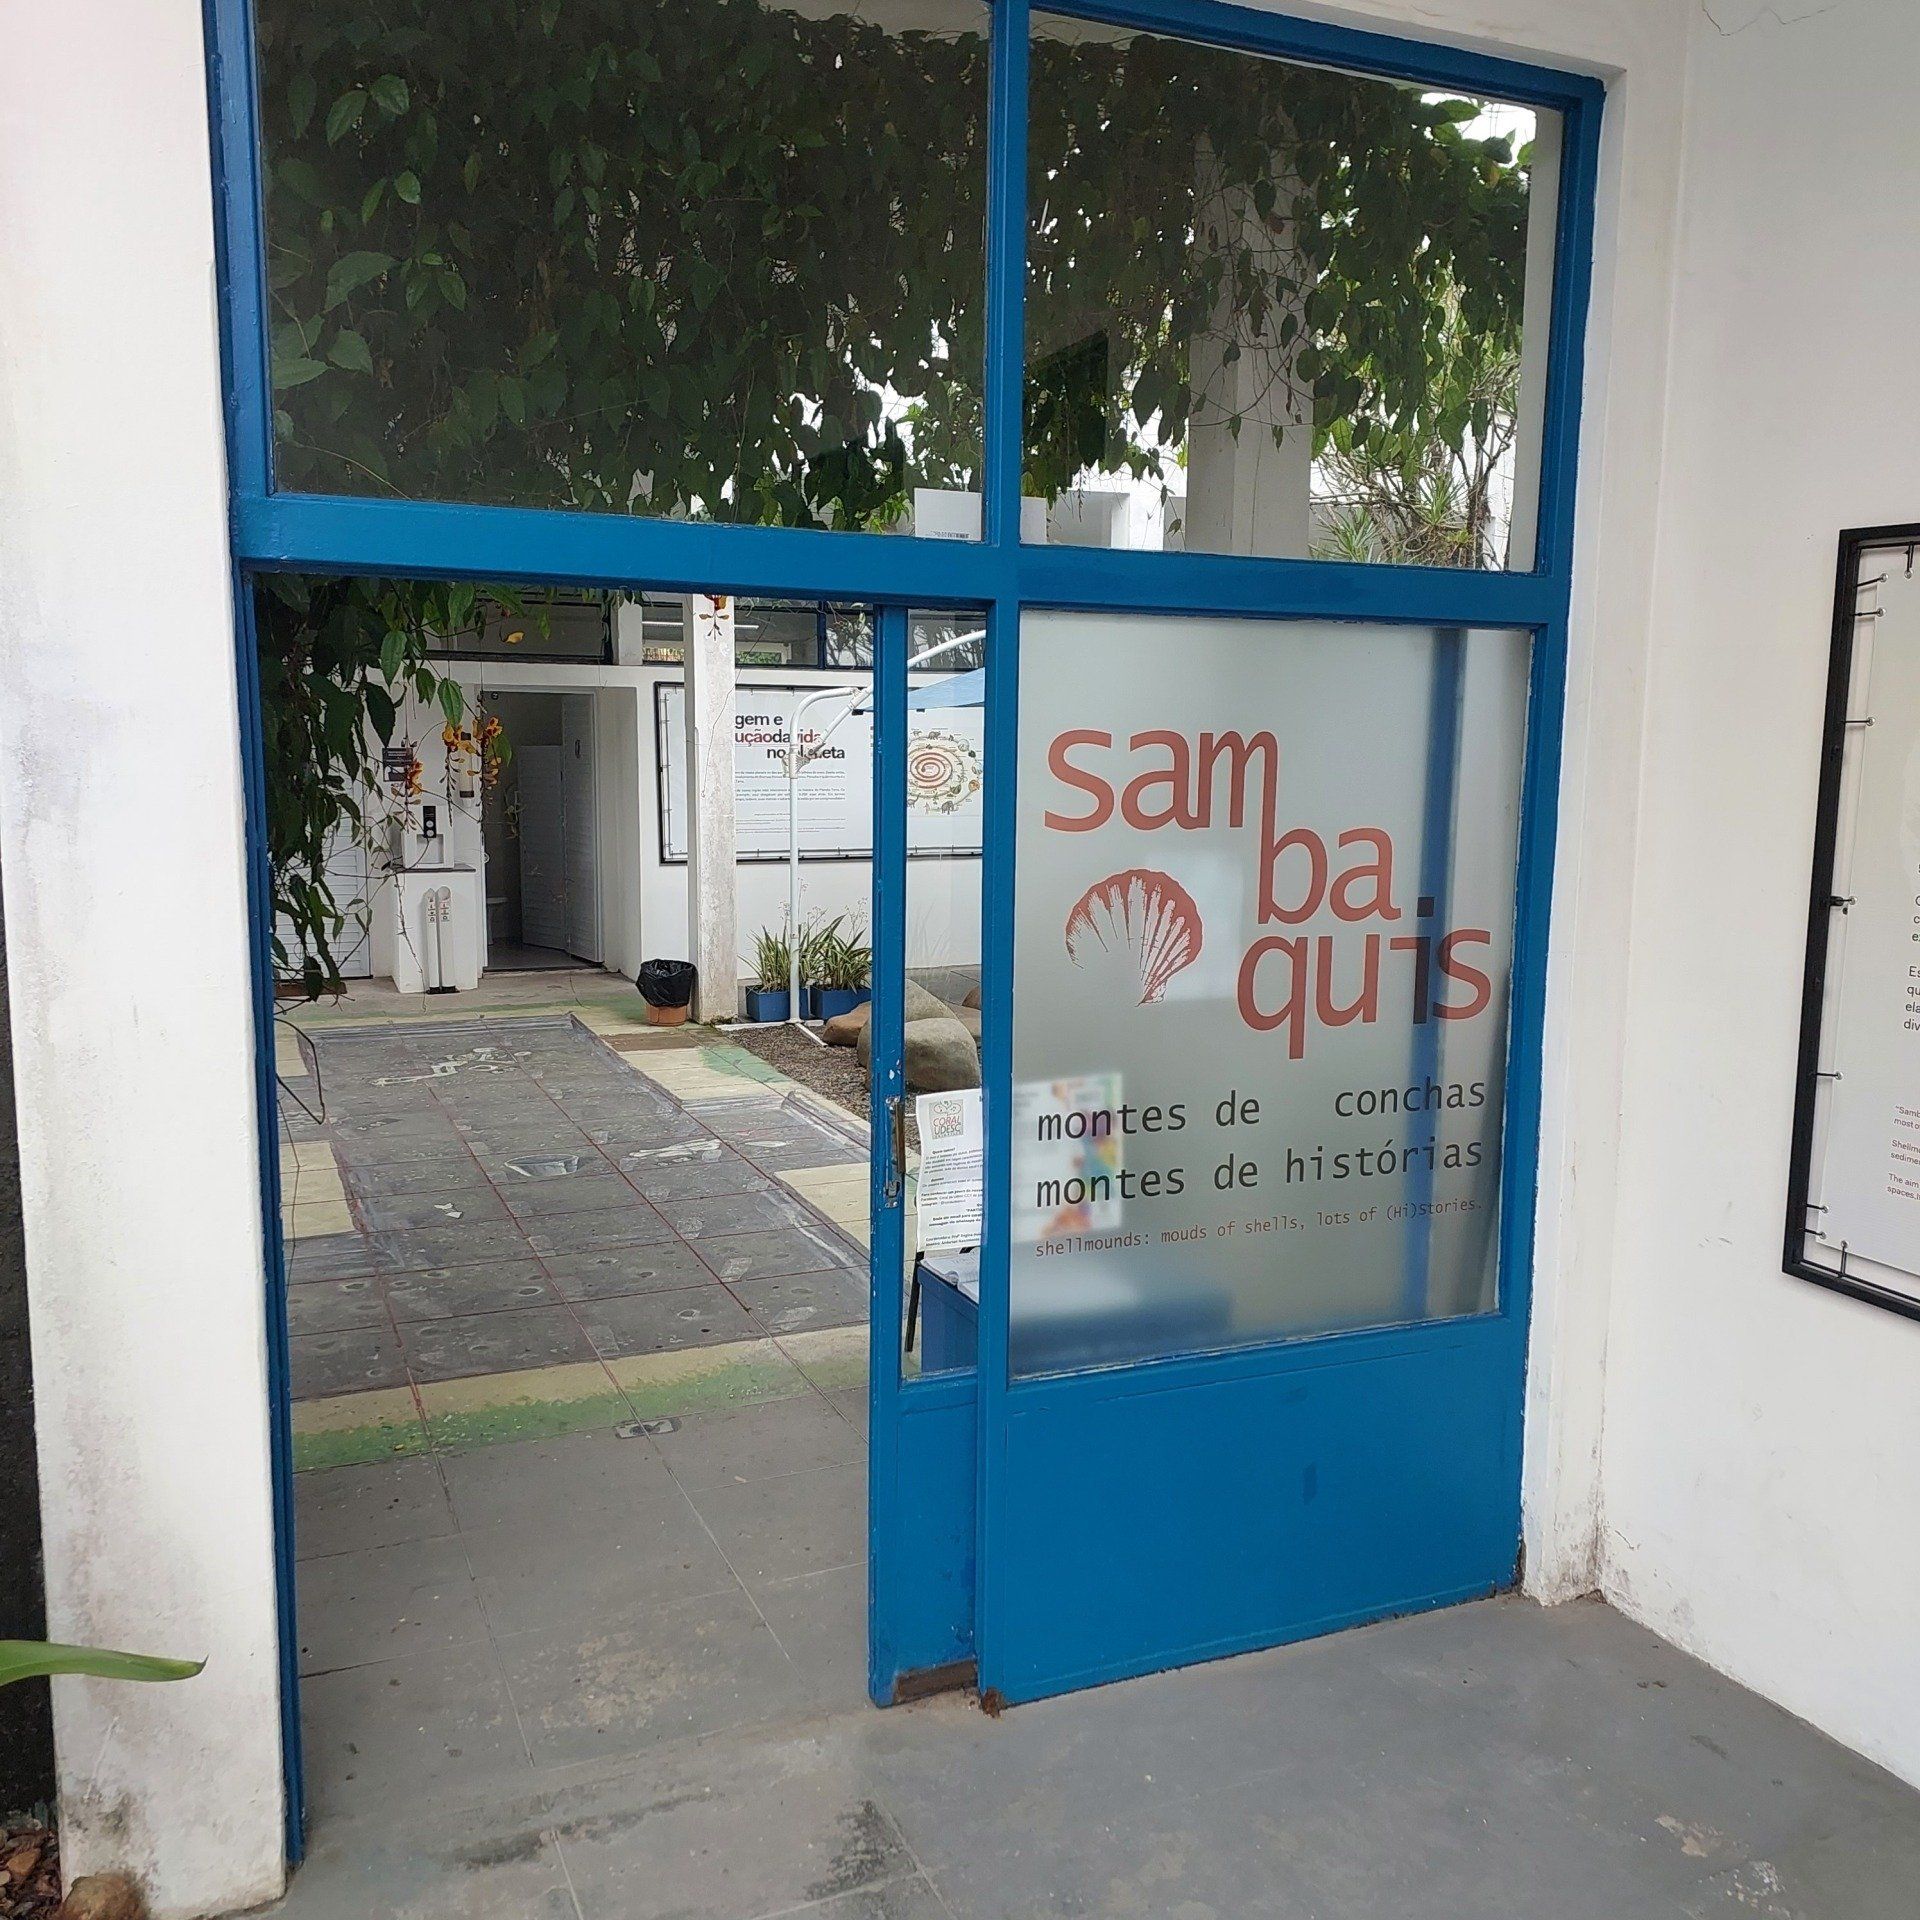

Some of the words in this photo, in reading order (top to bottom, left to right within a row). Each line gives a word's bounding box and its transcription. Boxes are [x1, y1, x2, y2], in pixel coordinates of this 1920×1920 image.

[773, 715, 783, 725] e
[767, 748, 786, 758] no
[1044, 729, 1279, 832] sam
[1258, 816, 1401, 925] ba
[1237, 896, 1494, 1060] quis
[933, 1115, 961, 1127] CORAL
[1037, 1102, 1187, 1141] montes
[1215, 1090, 1261, 1127] de
[1335, 1076, 1486, 1118] conchas
[1893, 1118, 1913, 1129] most
[1036, 1166, 1185, 1208] montes
[1214, 1153, 1258, 1190] de
[1286, 1138, 1483, 1183] histórias
[1887, 1172, 1903, 1184] The
[1905, 1178, 1919, 1189] aim
[1035, 1230, 1150, 1257] shellmounds:
[1161, 1221, 1207, 1243] mouds
[1217, 1219, 1236, 1237] of
[1245, 1214, 1305, 1235] shells,
[1316, 1208, 1350, 1227] lots
[1360, 1205, 1377, 1223] of
